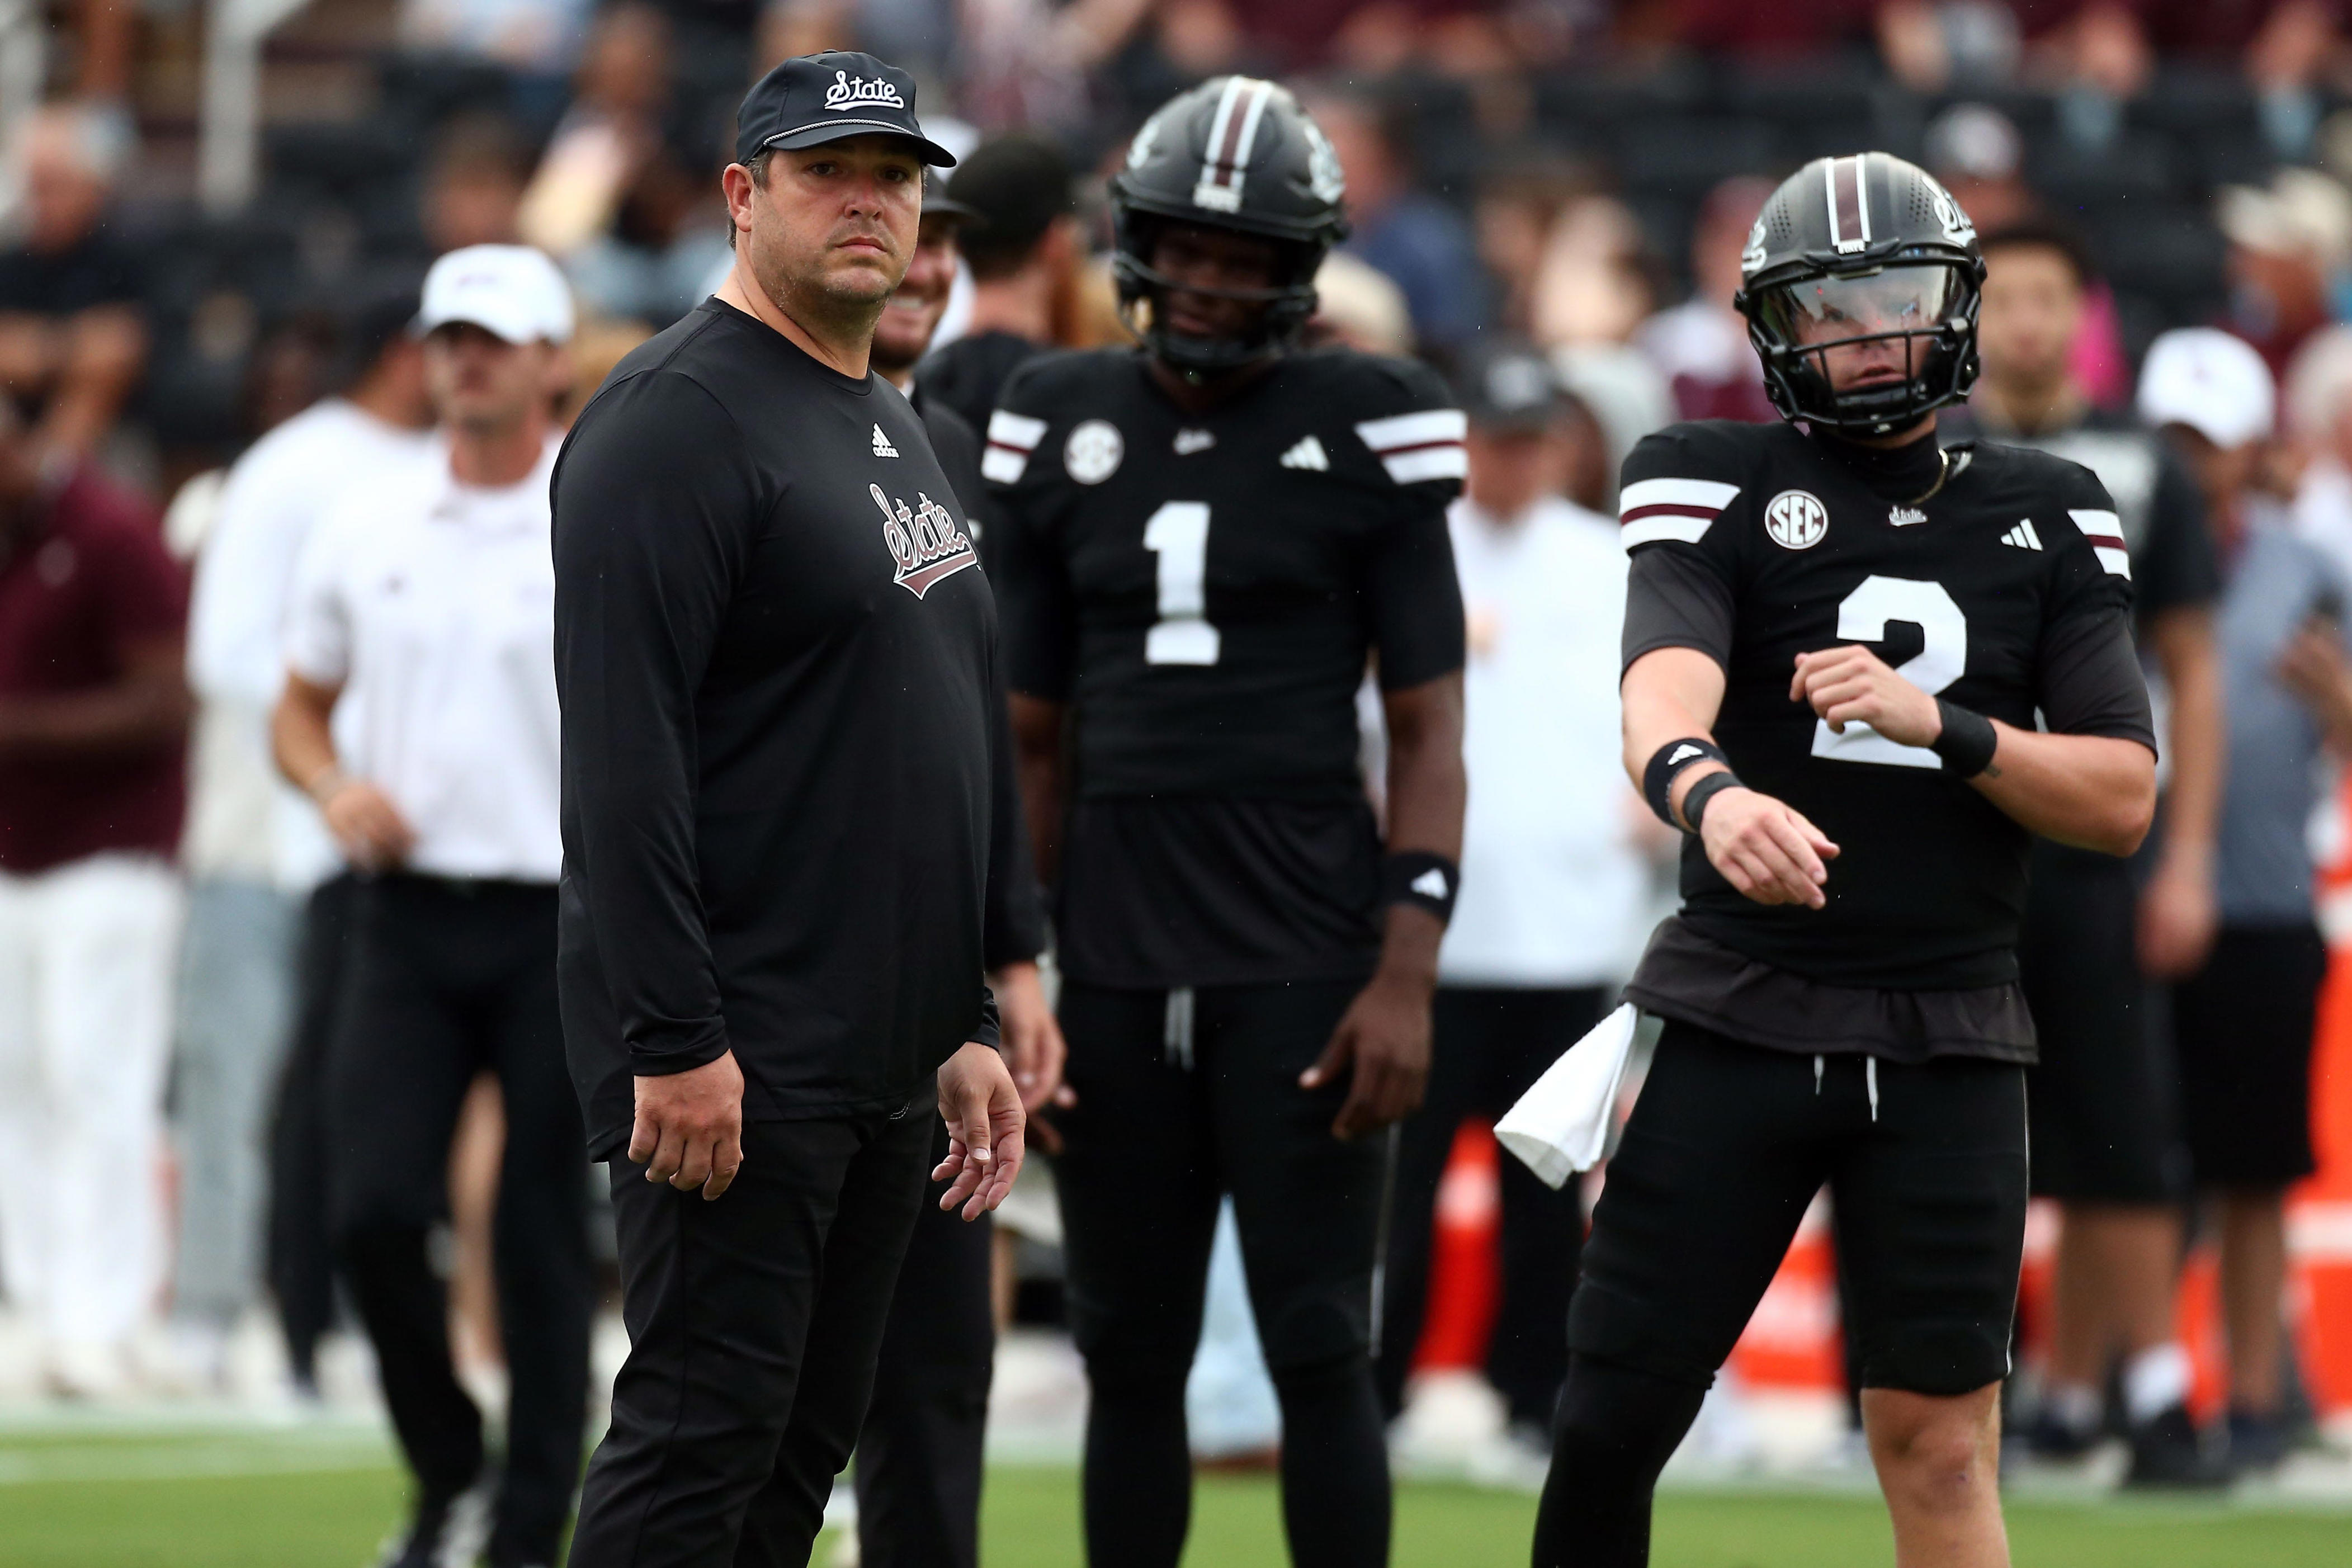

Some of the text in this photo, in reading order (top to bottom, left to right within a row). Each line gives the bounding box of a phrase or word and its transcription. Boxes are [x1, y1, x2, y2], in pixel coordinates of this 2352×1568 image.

[825, 70, 904, 111] State
[872, 447, 899, 458] adidas
[869, 483, 977, 601] State
[1770, 494, 1823, 545] SEC
[1143, 500, 1220, 665] 1
[1811, 574, 1967, 769] 2
